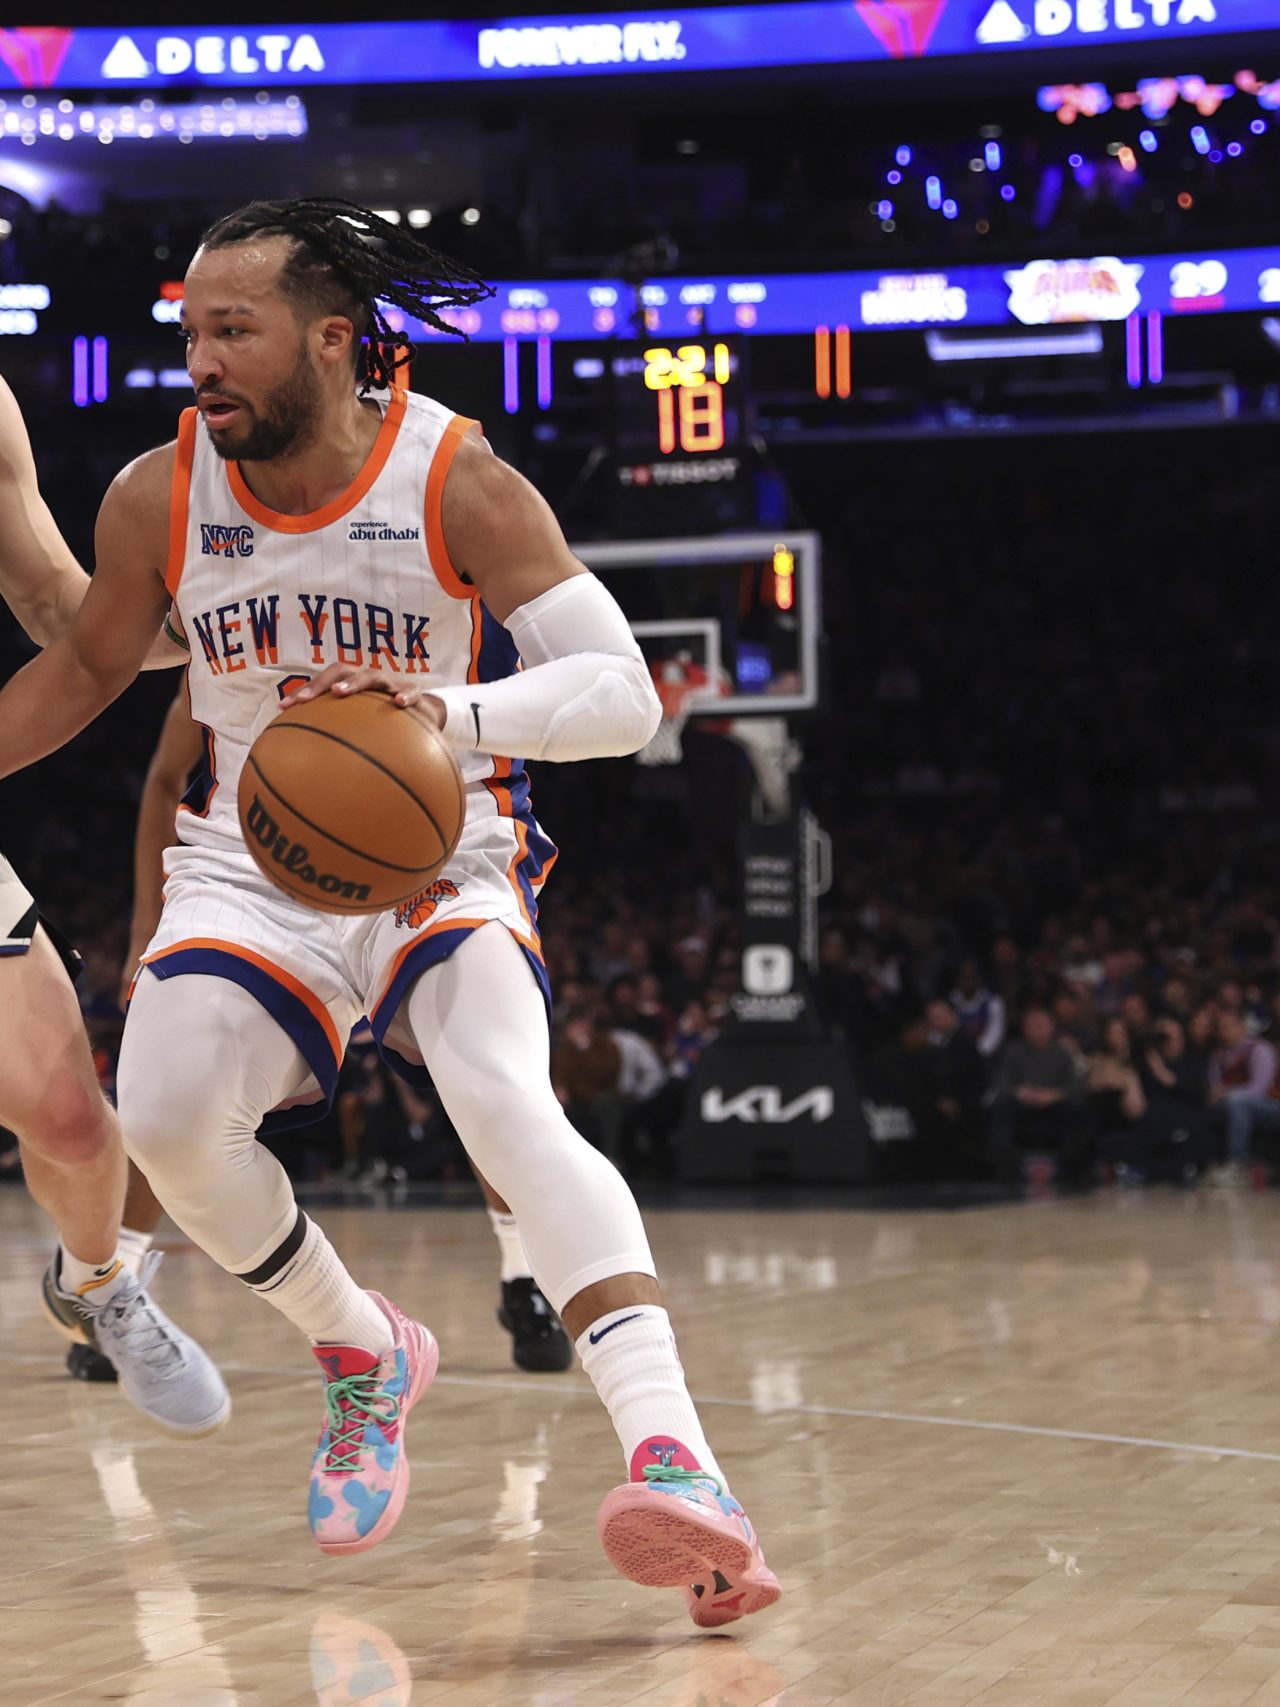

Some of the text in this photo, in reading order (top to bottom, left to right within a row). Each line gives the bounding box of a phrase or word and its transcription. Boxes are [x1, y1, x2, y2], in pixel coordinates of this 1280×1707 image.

[1034, 0, 1217, 36] DELTA
[156, 34, 325, 74] DELTA
[658, 381, 724, 454] 18
[200, 524, 254, 558] NYC
[349, 527, 419, 540] abu dhabi
[192, 594, 430, 676] NEW YORK
[246, 792, 373, 901] Wilson
